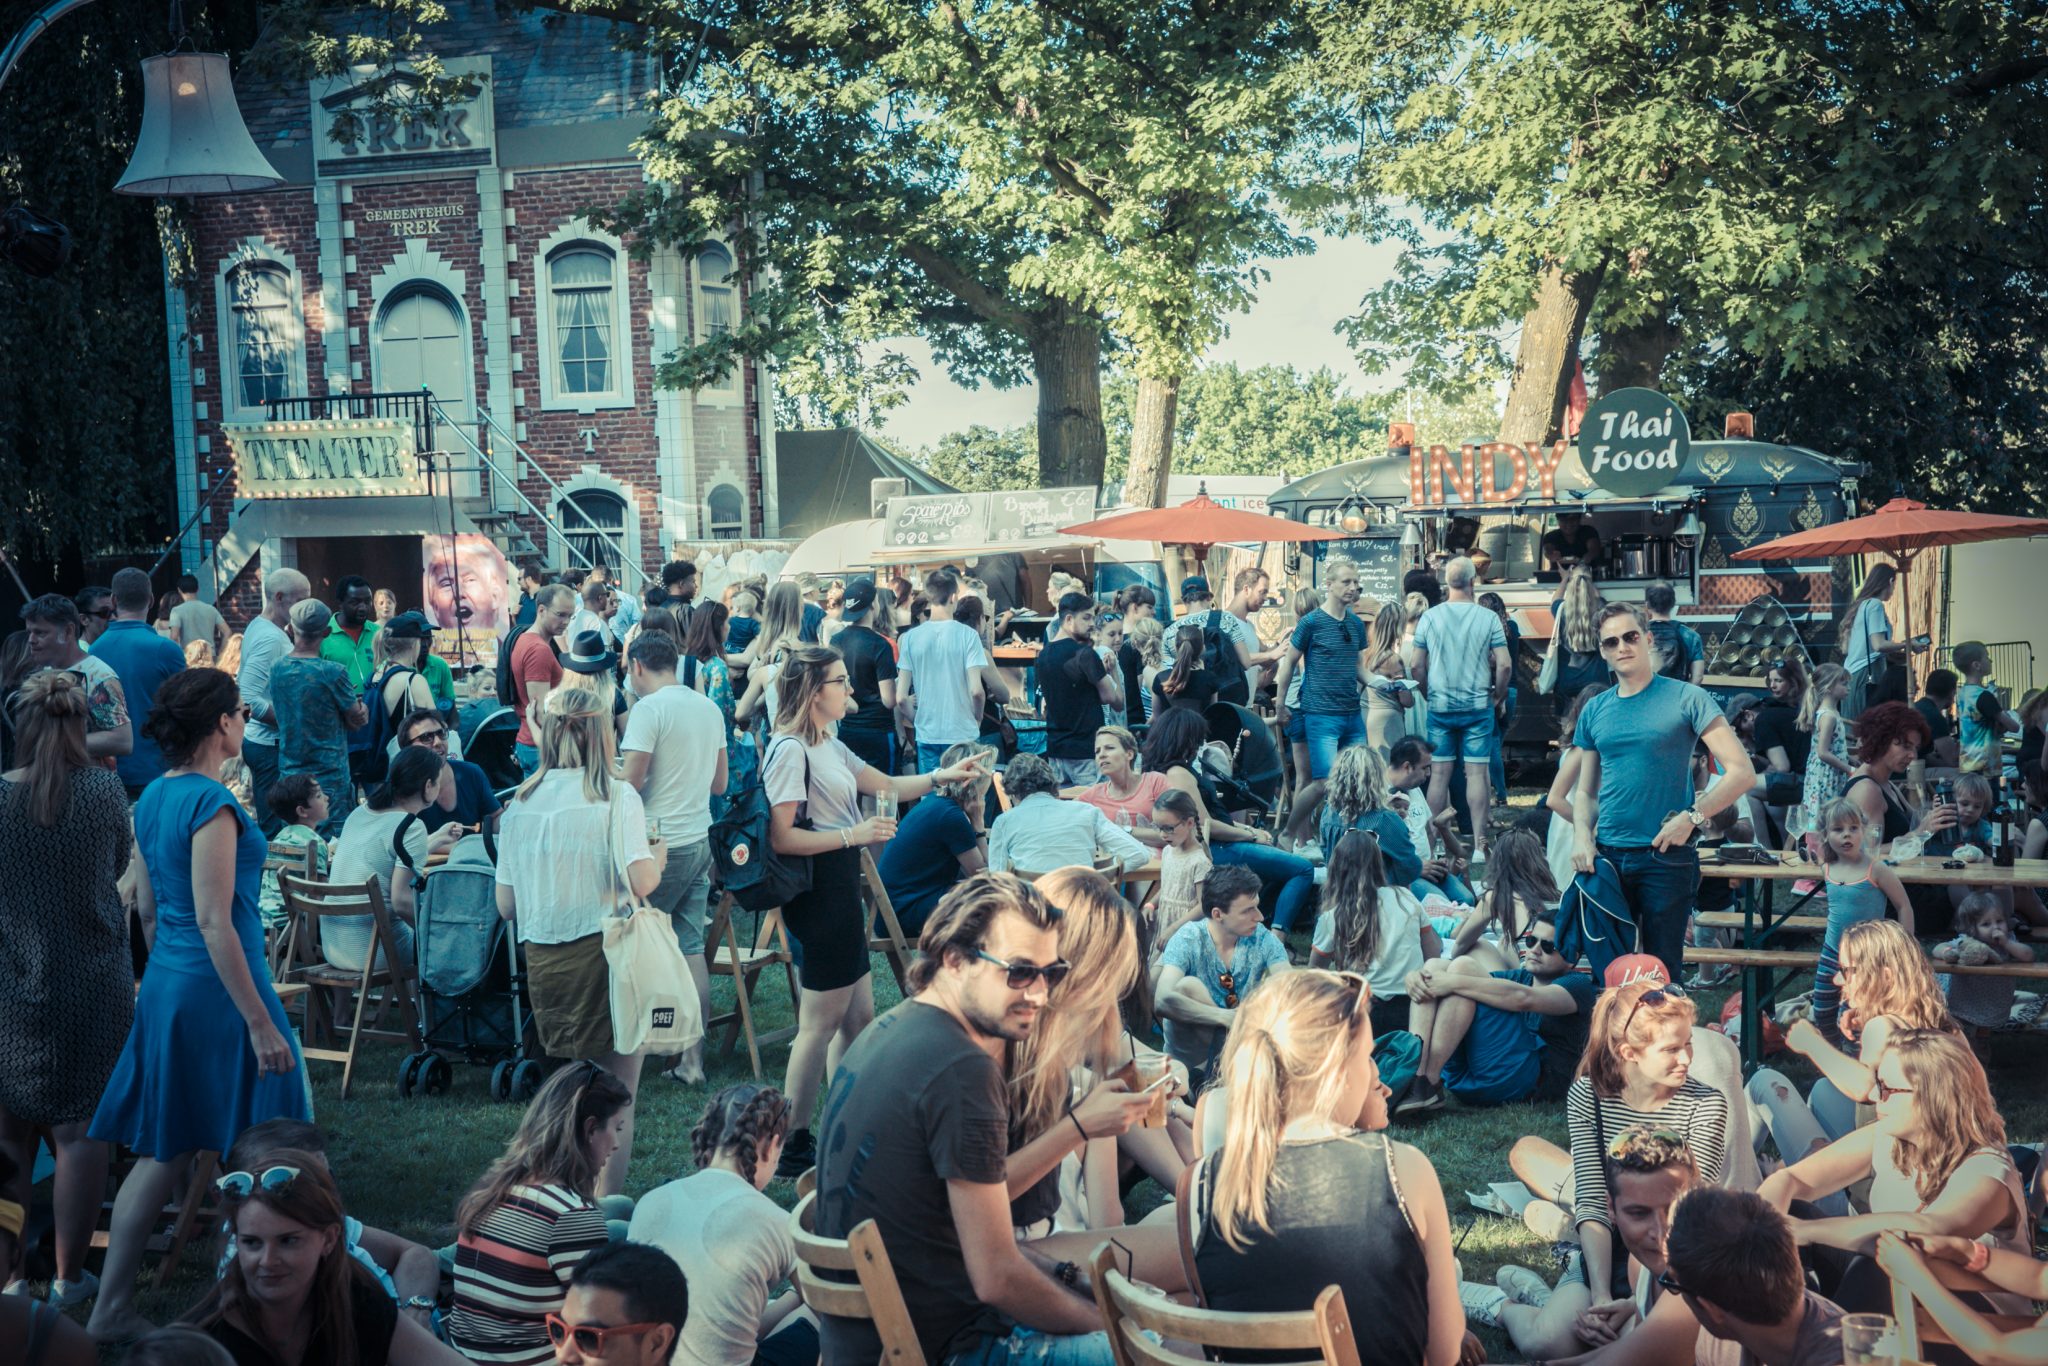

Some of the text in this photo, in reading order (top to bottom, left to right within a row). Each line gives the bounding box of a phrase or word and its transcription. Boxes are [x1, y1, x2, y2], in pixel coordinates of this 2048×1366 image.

[333, 108, 472, 156] TREK
[365, 204, 465, 222] GEMEENTEHUIS
[390, 219, 441, 237] TREK
[1599, 407, 1673, 441] Thai
[244, 436, 404, 481] THEATER
[1409, 439, 1569, 505] INDY
[1591, 439, 1678, 474] Food
[899, 498, 971, 528] Spare Ribs
[1351, 540, 1374, 550] INDY
[653, 1012, 674, 1024] COEF
